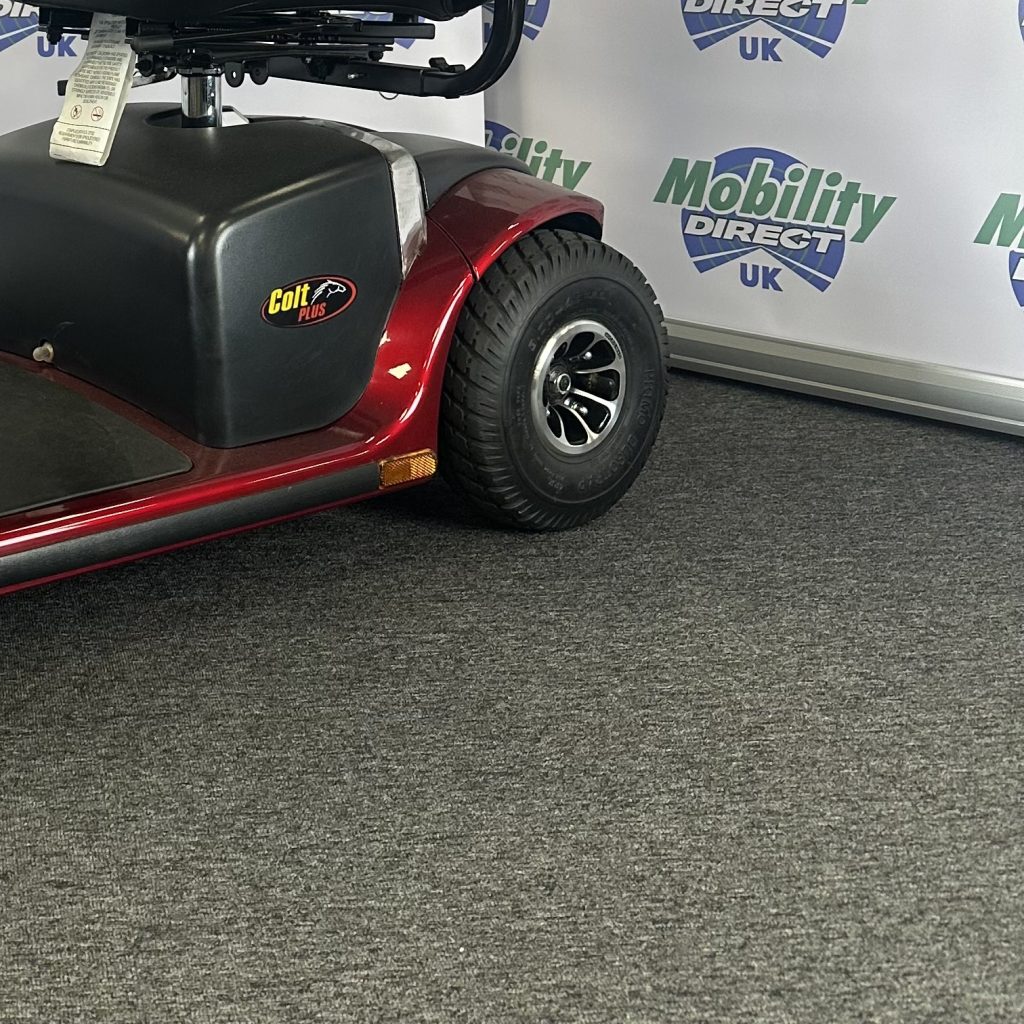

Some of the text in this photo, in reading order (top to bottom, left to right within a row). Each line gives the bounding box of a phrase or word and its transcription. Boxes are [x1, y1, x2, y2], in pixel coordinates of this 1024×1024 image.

[739, 36, 780, 63] UK
[656, 160, 894, 241] Mobility
[684, 214, 842, 252] DIRECT
[739, 264, 780, 292] UK
[268, 283, 310, 315] Colt
[298, 302, 328, 322] PLUS
